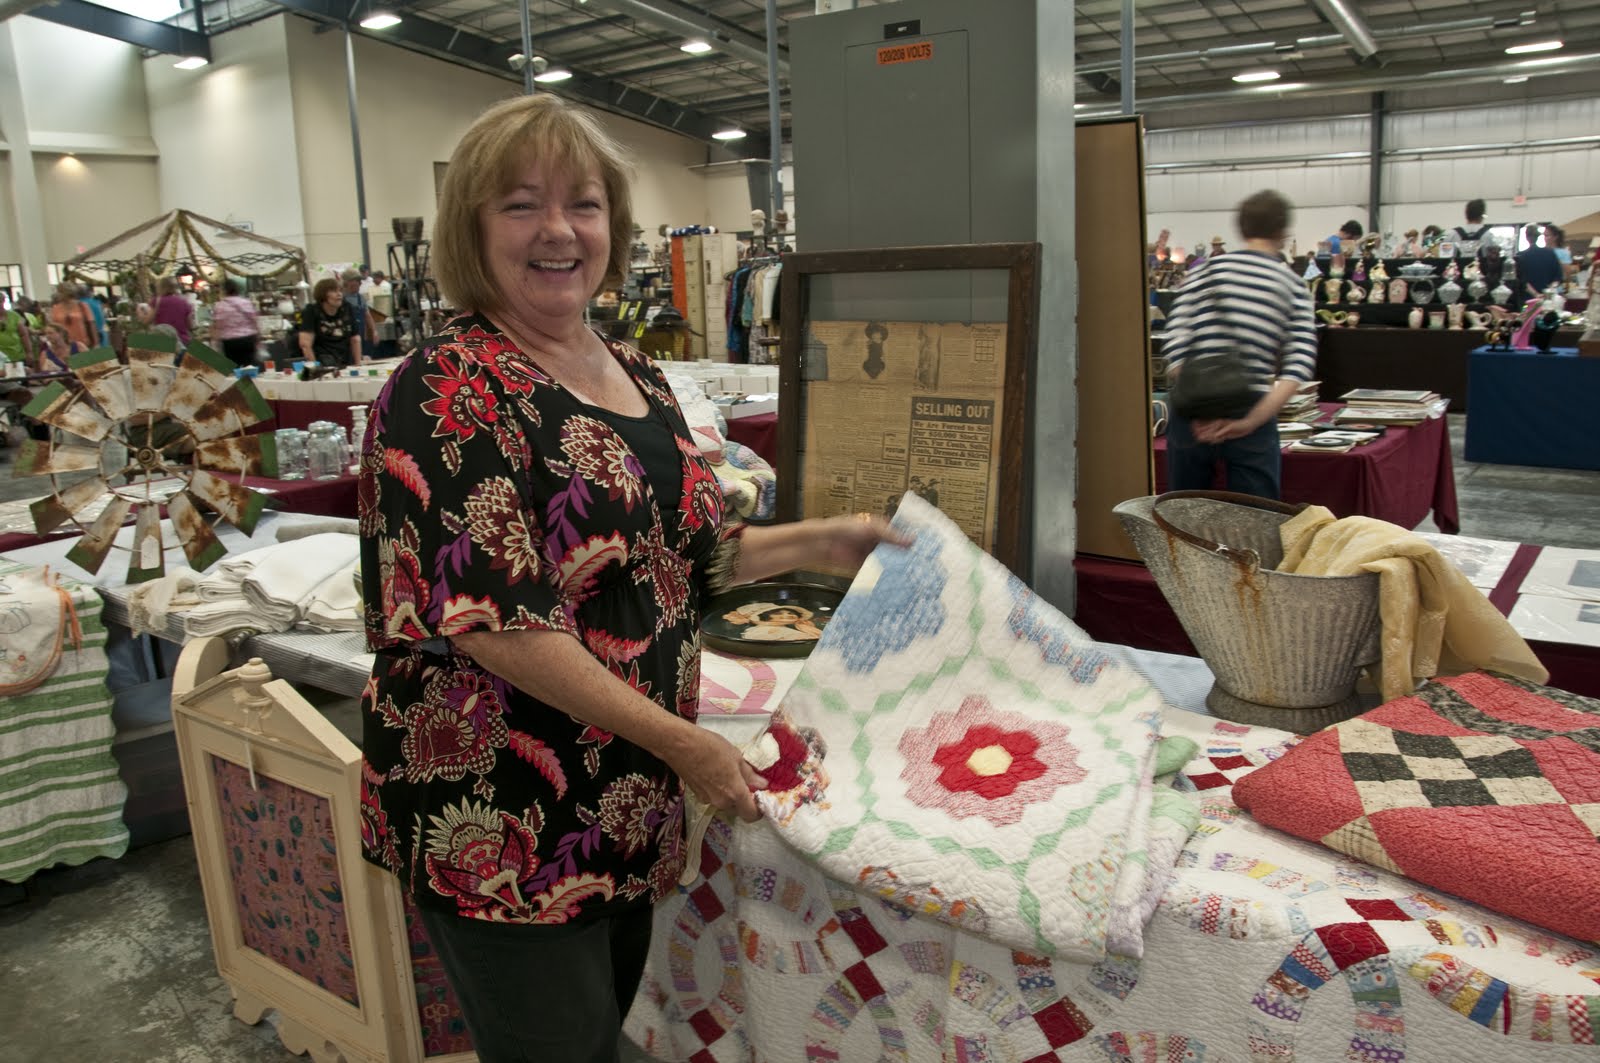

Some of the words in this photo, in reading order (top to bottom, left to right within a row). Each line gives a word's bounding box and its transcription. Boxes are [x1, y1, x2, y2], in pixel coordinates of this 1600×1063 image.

[906, 44, 932, 59] VOLTS
[915, 402, 962, 417] SELLING
[967, 405, 990, 418] OUT
[941, 422, 965, 430] Forced
[912, 429, 925, 437] Our
[959, 433, 979, 441] Stock
[933, 448, 959, 457] Dresses
[944, 458, 962, 466] Than
[964, 460, 980, 468] Cost
